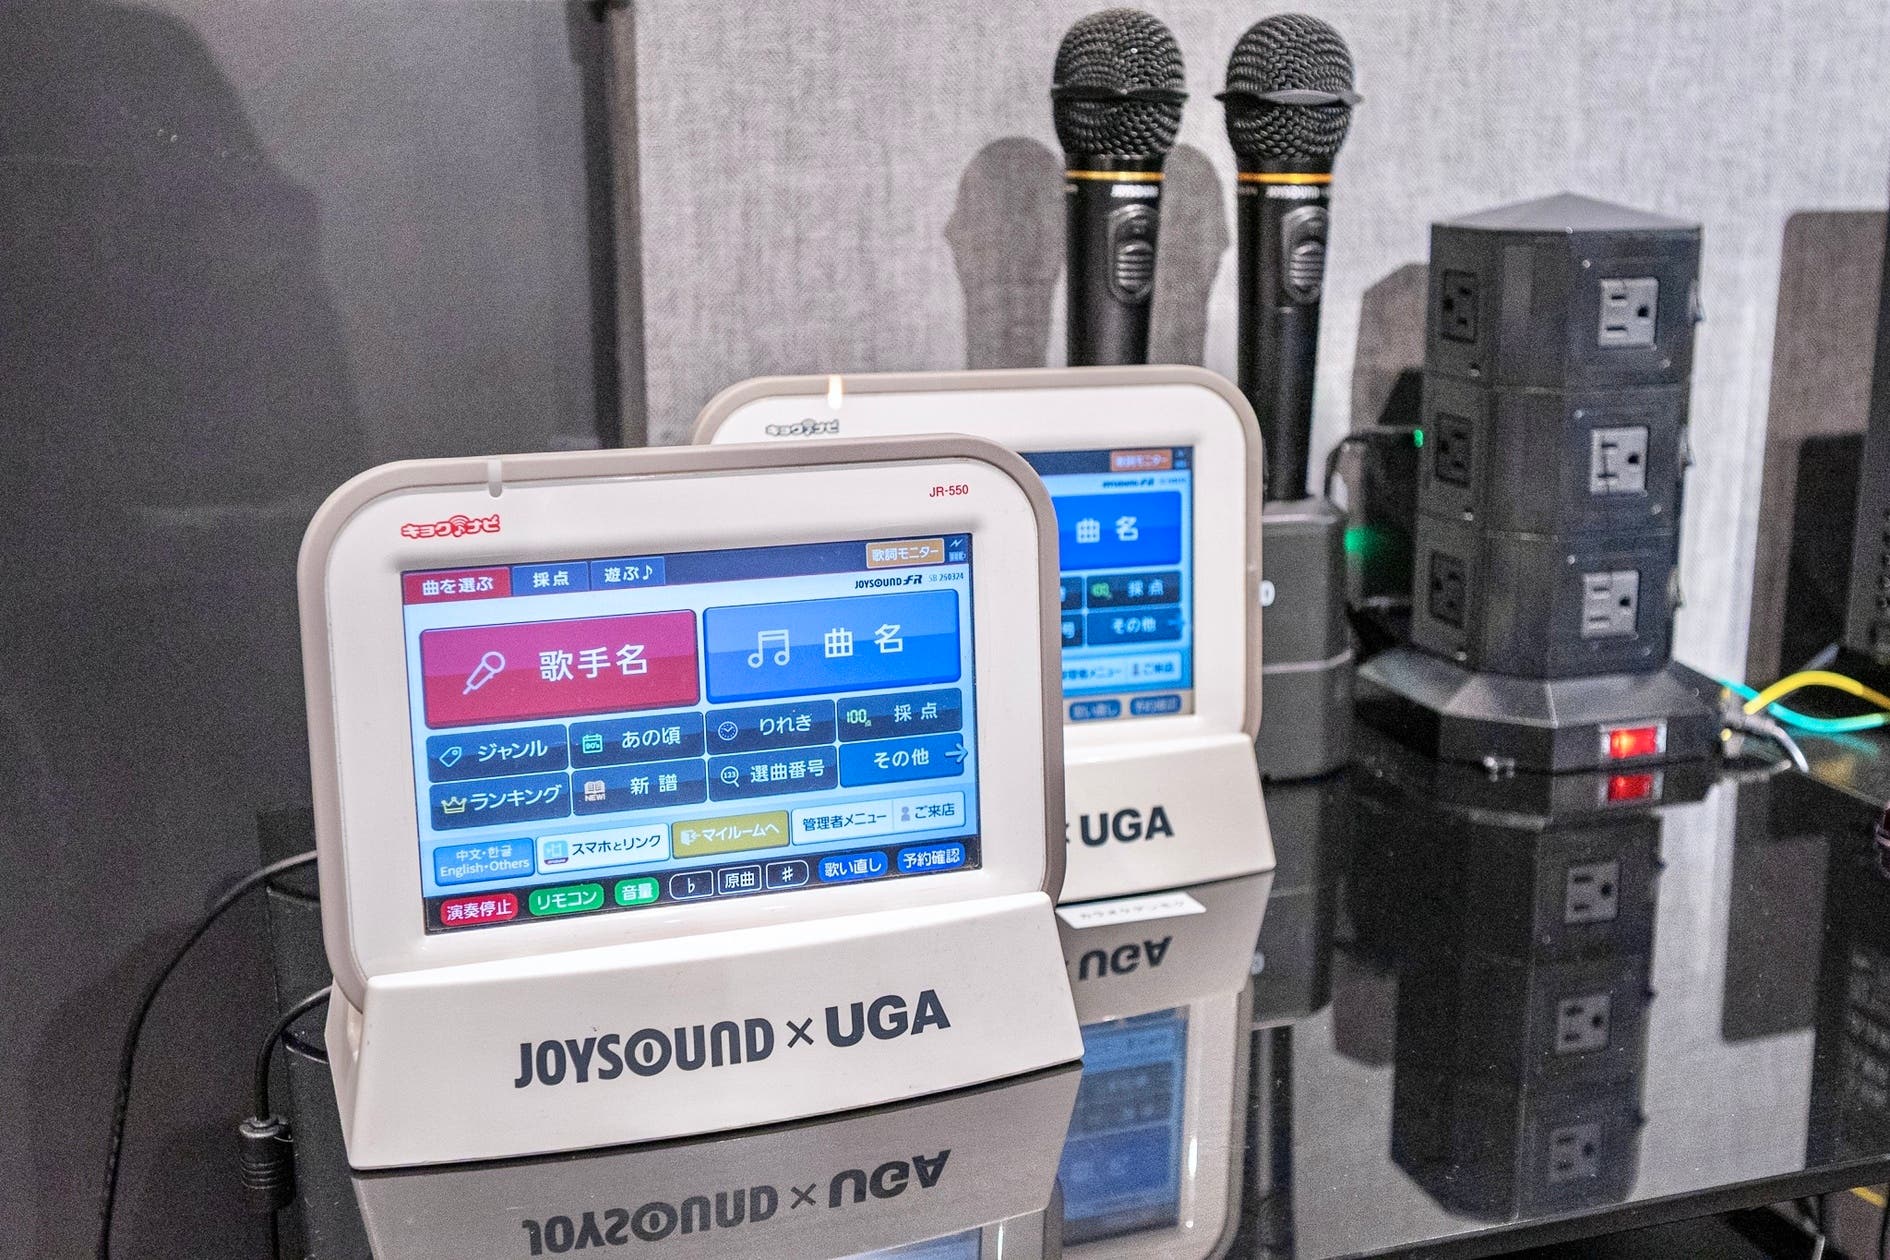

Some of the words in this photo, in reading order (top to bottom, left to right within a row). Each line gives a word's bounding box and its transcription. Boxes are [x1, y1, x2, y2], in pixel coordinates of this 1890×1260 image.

[929, 484, 969, 498] JR-550
[871, 546, 939, 562] 歌詞モニター
[422, 576, 494, 597] 曲を選ぶ
[532, 571, 570, 589] 採点
[855, 577, 902, 590] JOYSOUND
[823, 623, 904, 659] 曲名
[538, 643, 648, 683] 歌手名
[894, 702, 938, 723] 採点
[759, 714, 812, 736] りれき
[622, 726, 681, 749] あの頃
[478, 740, 549, 763] ジャンル
[873, 748, 930, 769] その他
[723, 771, 736, 779] 123
[750, 759, 825, 784] 選曲番号
[630, 773, 678, 796] 新譜
[470, 784, 562, 811] ランキング
[914, 802, 955, 820] ご来店
[702, 823, 780, 842] マイルームへ
[802, 812, 887, 832] 管理者メニュー
[1079, 806, 1174, 847] UGA
[572, 835, 661, 856] スマホとリンク
[824, 859, 882, 877] 歌い直し
[903, 848, 961, 869] 予約確認
[724, 873, 755, 889] 原曲
[536, 891, 598, 910] リモコン
[621, 883, 653, 901] 音量
[446, 899, 512, 921] 演奏停止
[514, 1017, 775, 1089] JOYSOUND
[824, 989, 951, 1048] UGA
